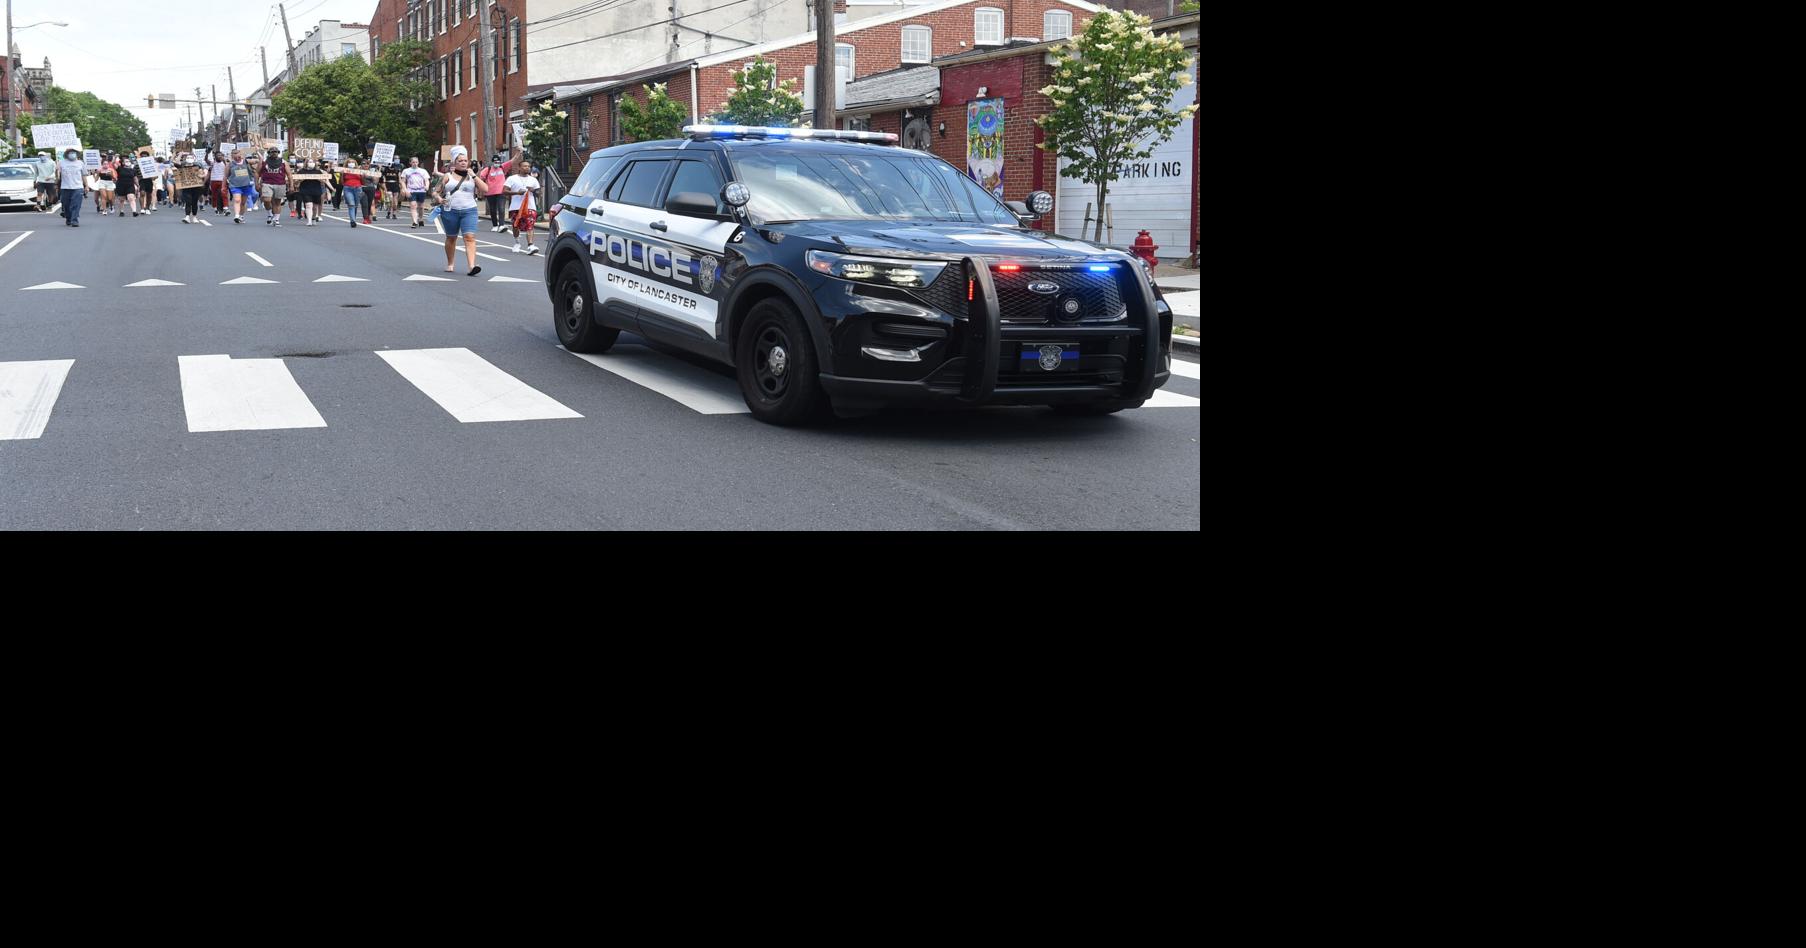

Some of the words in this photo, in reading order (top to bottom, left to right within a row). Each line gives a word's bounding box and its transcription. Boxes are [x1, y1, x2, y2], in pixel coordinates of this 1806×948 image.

[294, 138, 324, 148] DEFUND
[294, 148, 322, 158] COPS
[733, 231, 746, 242] 6
[590, 230, 693, 285] POLICE
[607, 272, 626, 286] CITY
[628, 279, 640, 290] OF
[640, 285, 697, 310] LANCASTER
